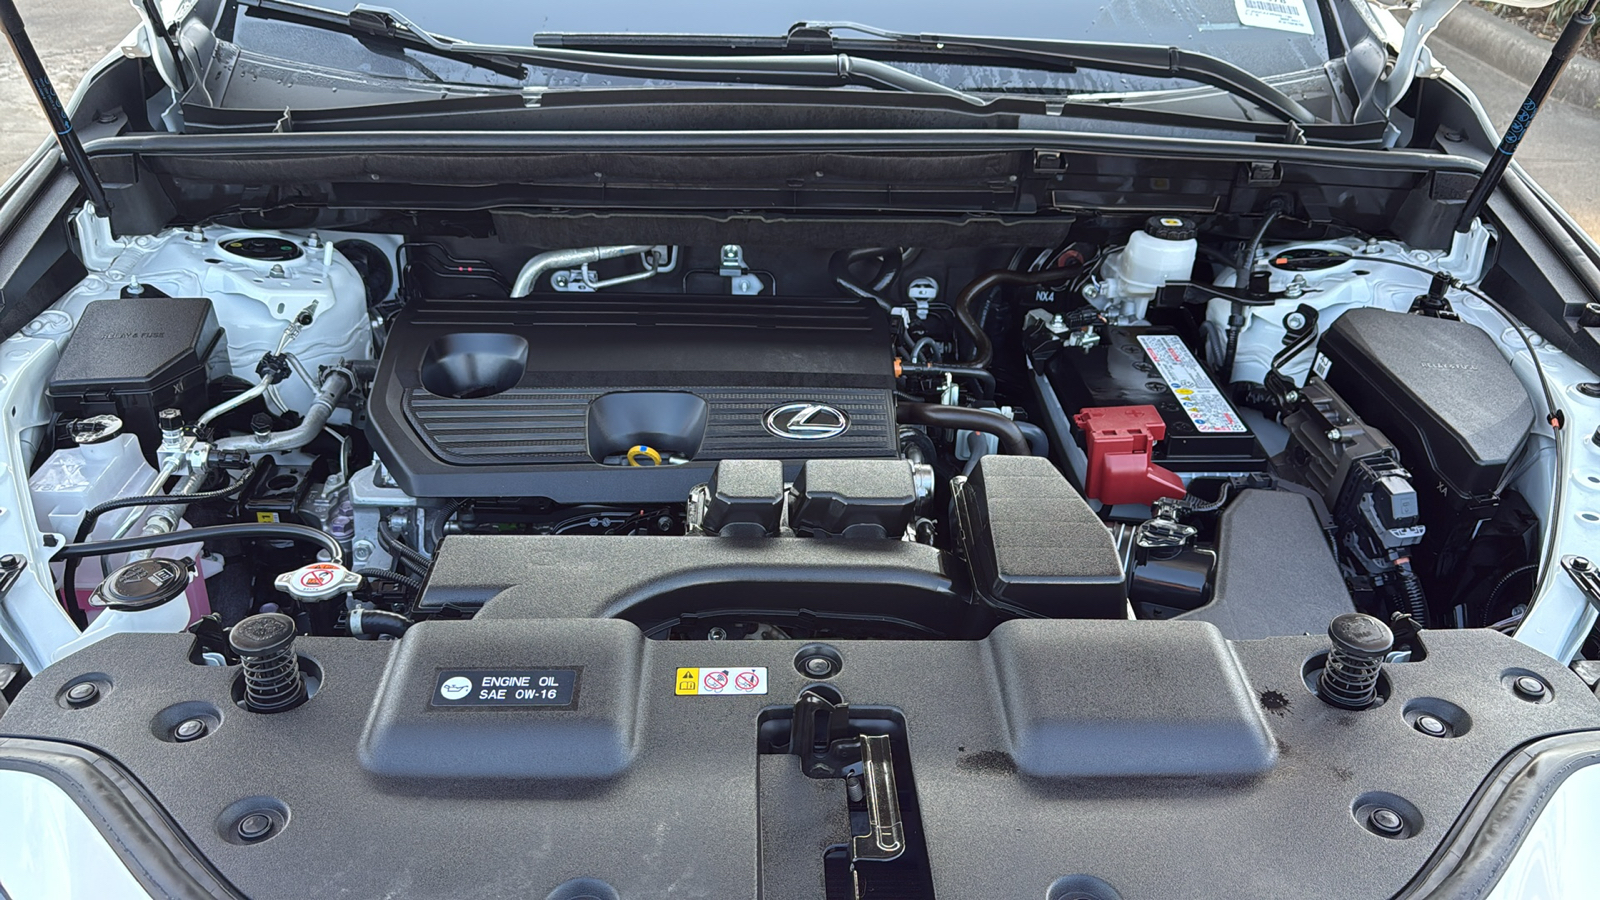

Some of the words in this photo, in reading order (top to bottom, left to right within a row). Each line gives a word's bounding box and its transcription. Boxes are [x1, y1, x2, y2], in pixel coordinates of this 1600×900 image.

[1035, 290, 1055, 302] NX4
[481, 676, 530, 687] ENGINE
[538, 676, 559, 687] OIL
[479, 689, 507, 700] SAE
